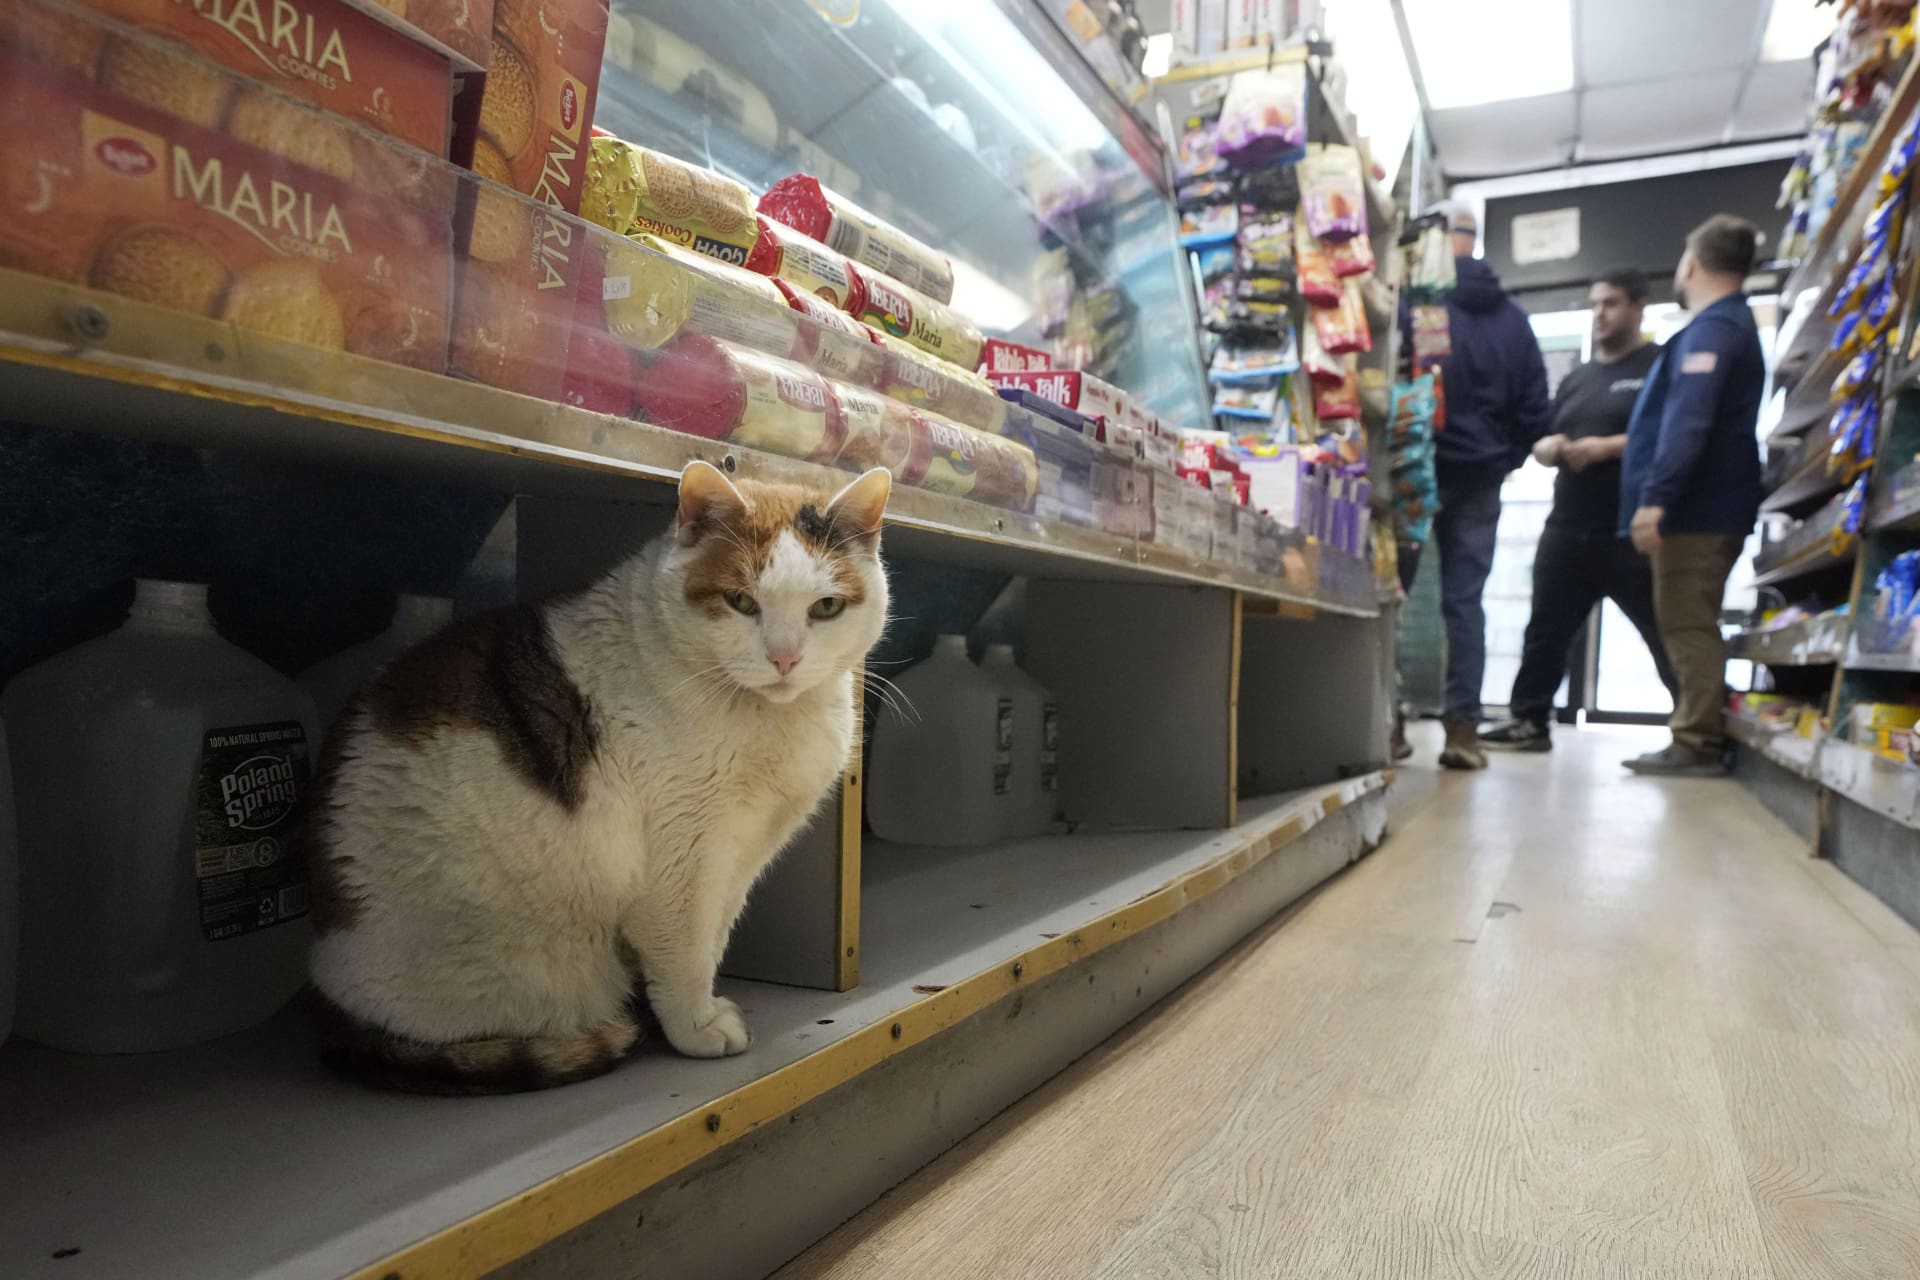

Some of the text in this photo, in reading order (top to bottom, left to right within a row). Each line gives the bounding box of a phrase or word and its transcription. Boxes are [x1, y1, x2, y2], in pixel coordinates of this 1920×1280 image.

[173, 144, 353, 254] MARIA
[536, 134, 577, 290] MARIA
[636, 215, 693, 244] Cookies
[869, 280, 911, 326] IBERIA
[782, 377, 826, 407] IBERIA
[1035, 375, 1071, 404] Talk
[209, 736, 229, 748] 100%
[229, 733, 258, 746] NATURAL
[220, 754, 294, 805] Poland
[224, 780, 297, 828] Spring
